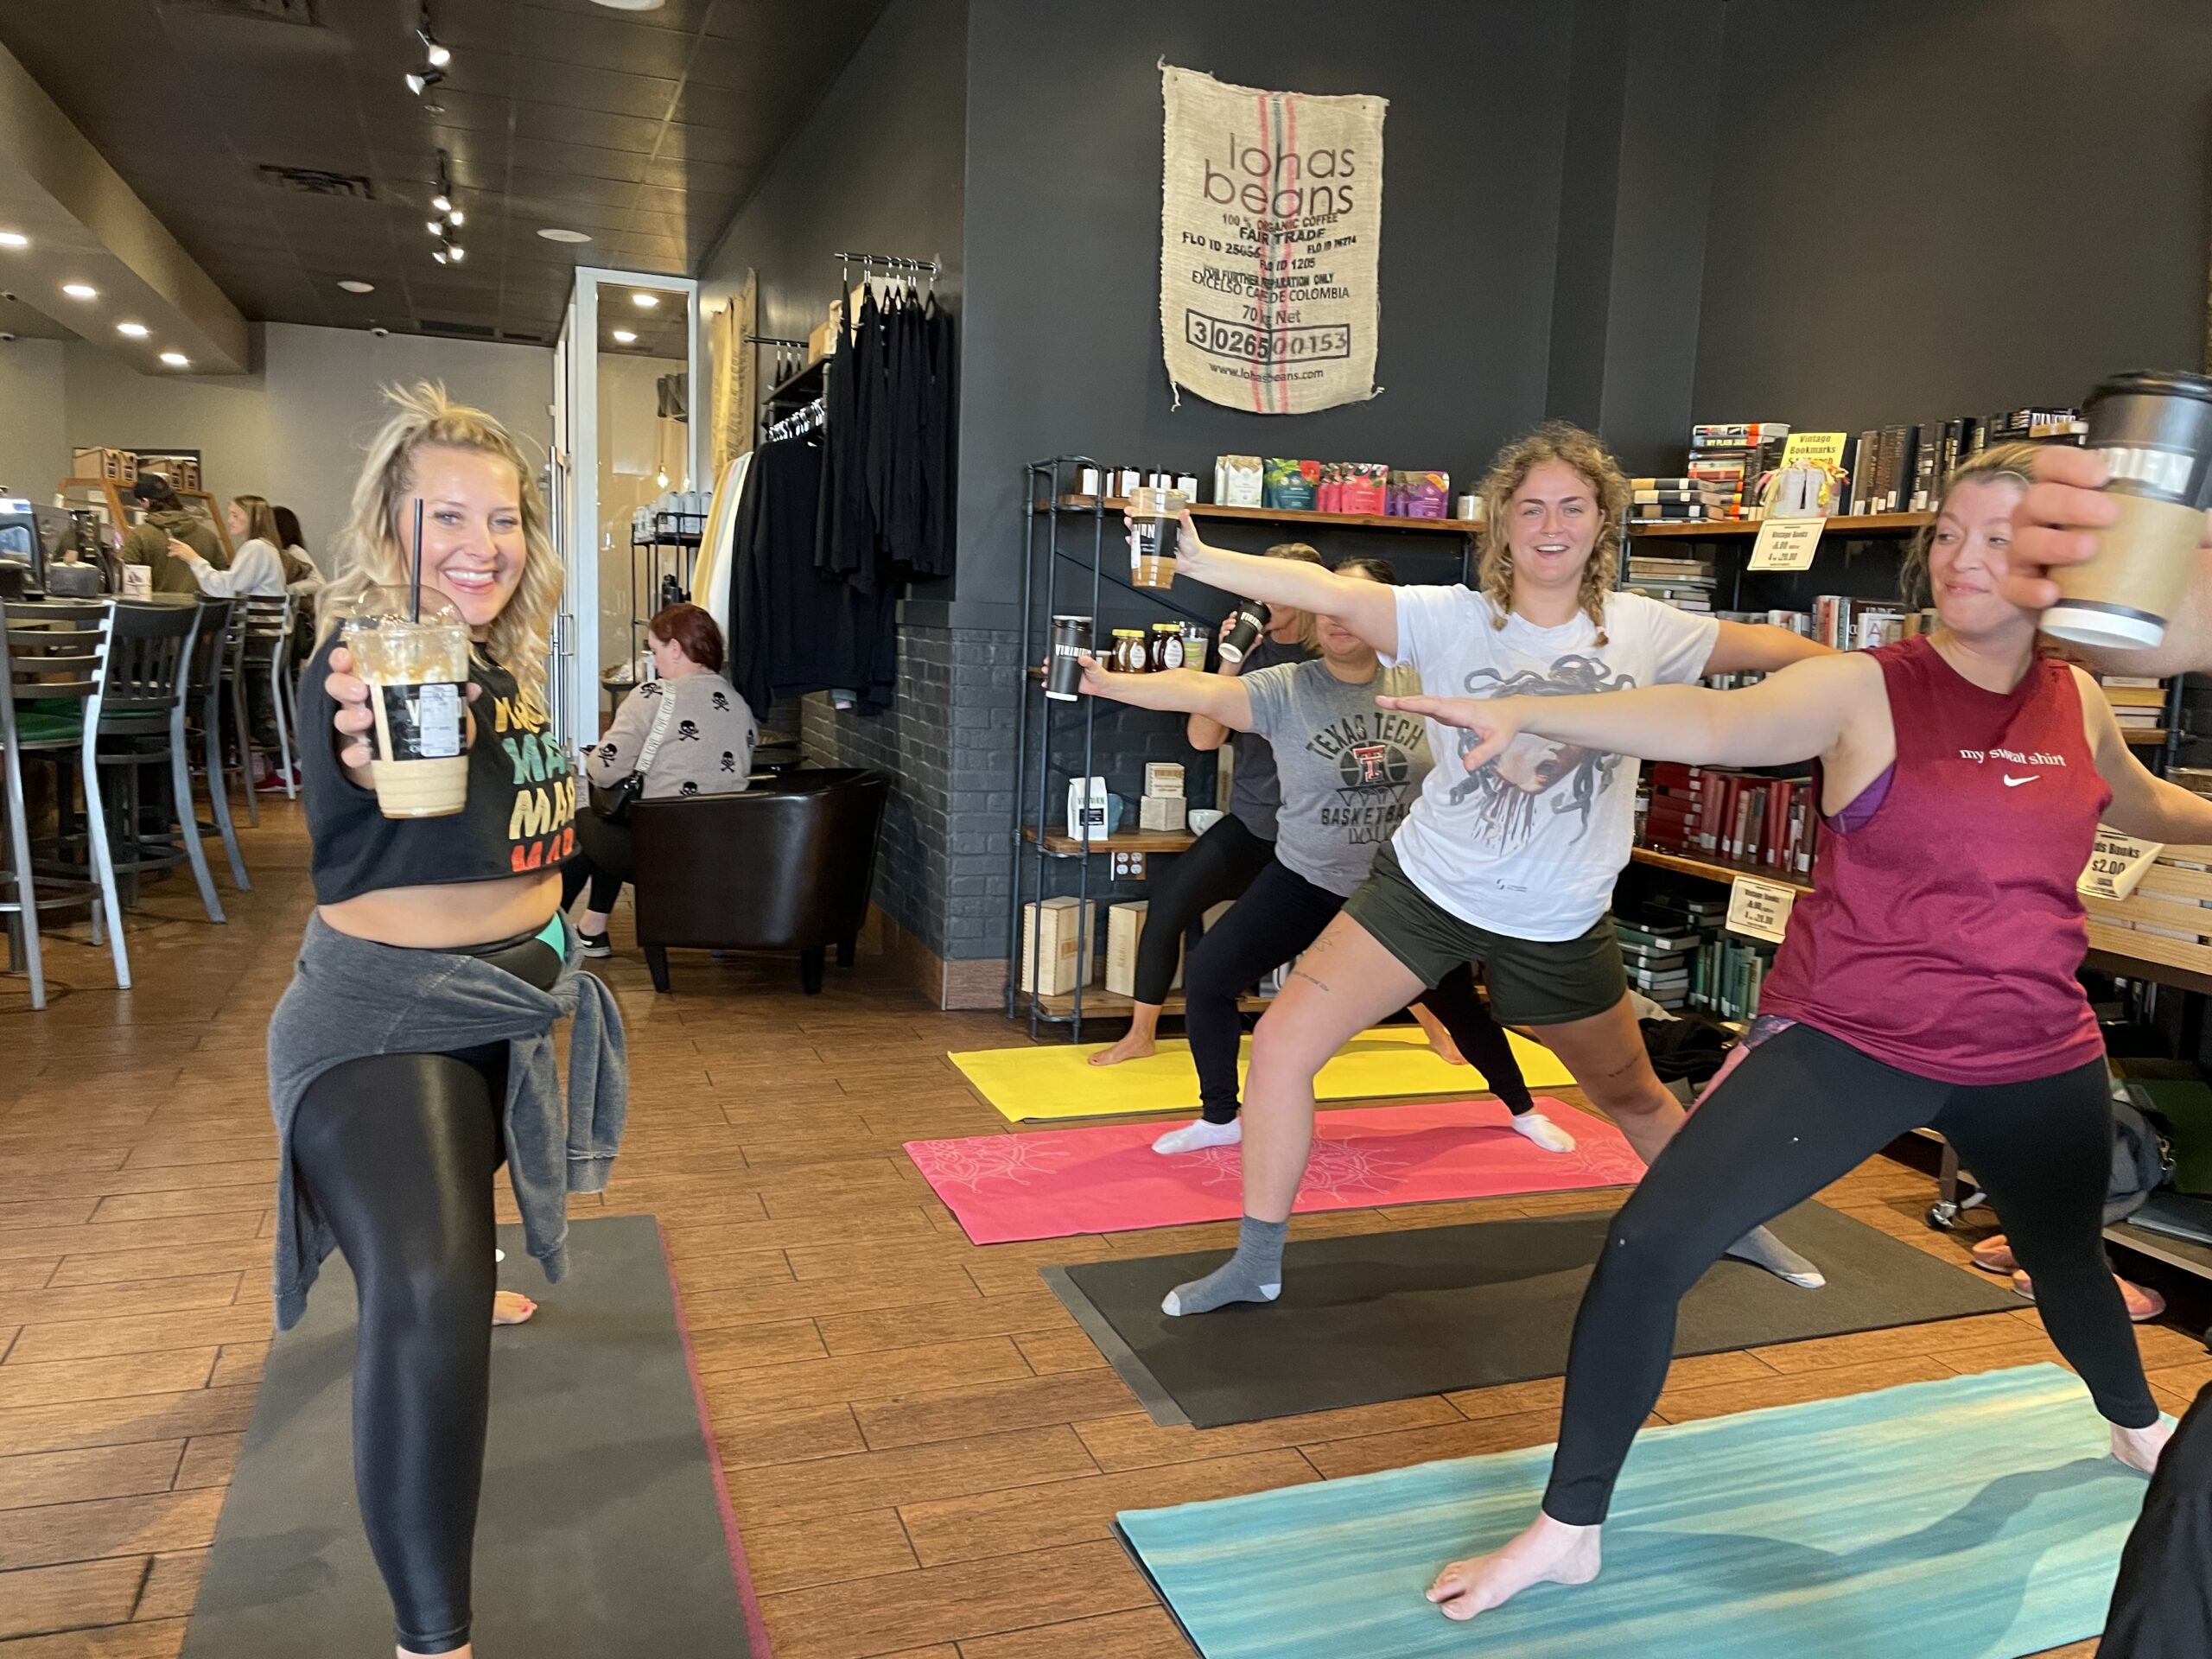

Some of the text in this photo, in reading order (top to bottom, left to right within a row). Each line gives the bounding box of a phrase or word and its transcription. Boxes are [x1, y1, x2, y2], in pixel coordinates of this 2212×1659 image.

[1230, 132, 1355, 181] lohas
[1204, 158, 1354, 218] beans
[1223, 213, 1240, 226] 100
[1302, 213, 1338, 227] COFFEE
[1182, 232, 1205, 246] FLO
[1209, 239, 1222, 251] ID
[1239, 226, 1269, 245] FAIR
[1276, 259, 1287, 271] ID
[1291, 257, 1315, 270] 1205
[1192, 270, 1243, 296] EXCELSO
[1289, 287, 1350, 302] COLOMBIA
[1276, 309, 1301, 324] Net
[1194, 321, 1208, 344] 3
[1790, 446, 1836, 454] Bookmarks
[1306, 711, 1424, 760] TEXAS TECH
[1959, 749, 1985, 764] my
[2028, 752, 2067, 766] shirt
[1322, 804, 1412, 826] BASKETBA
